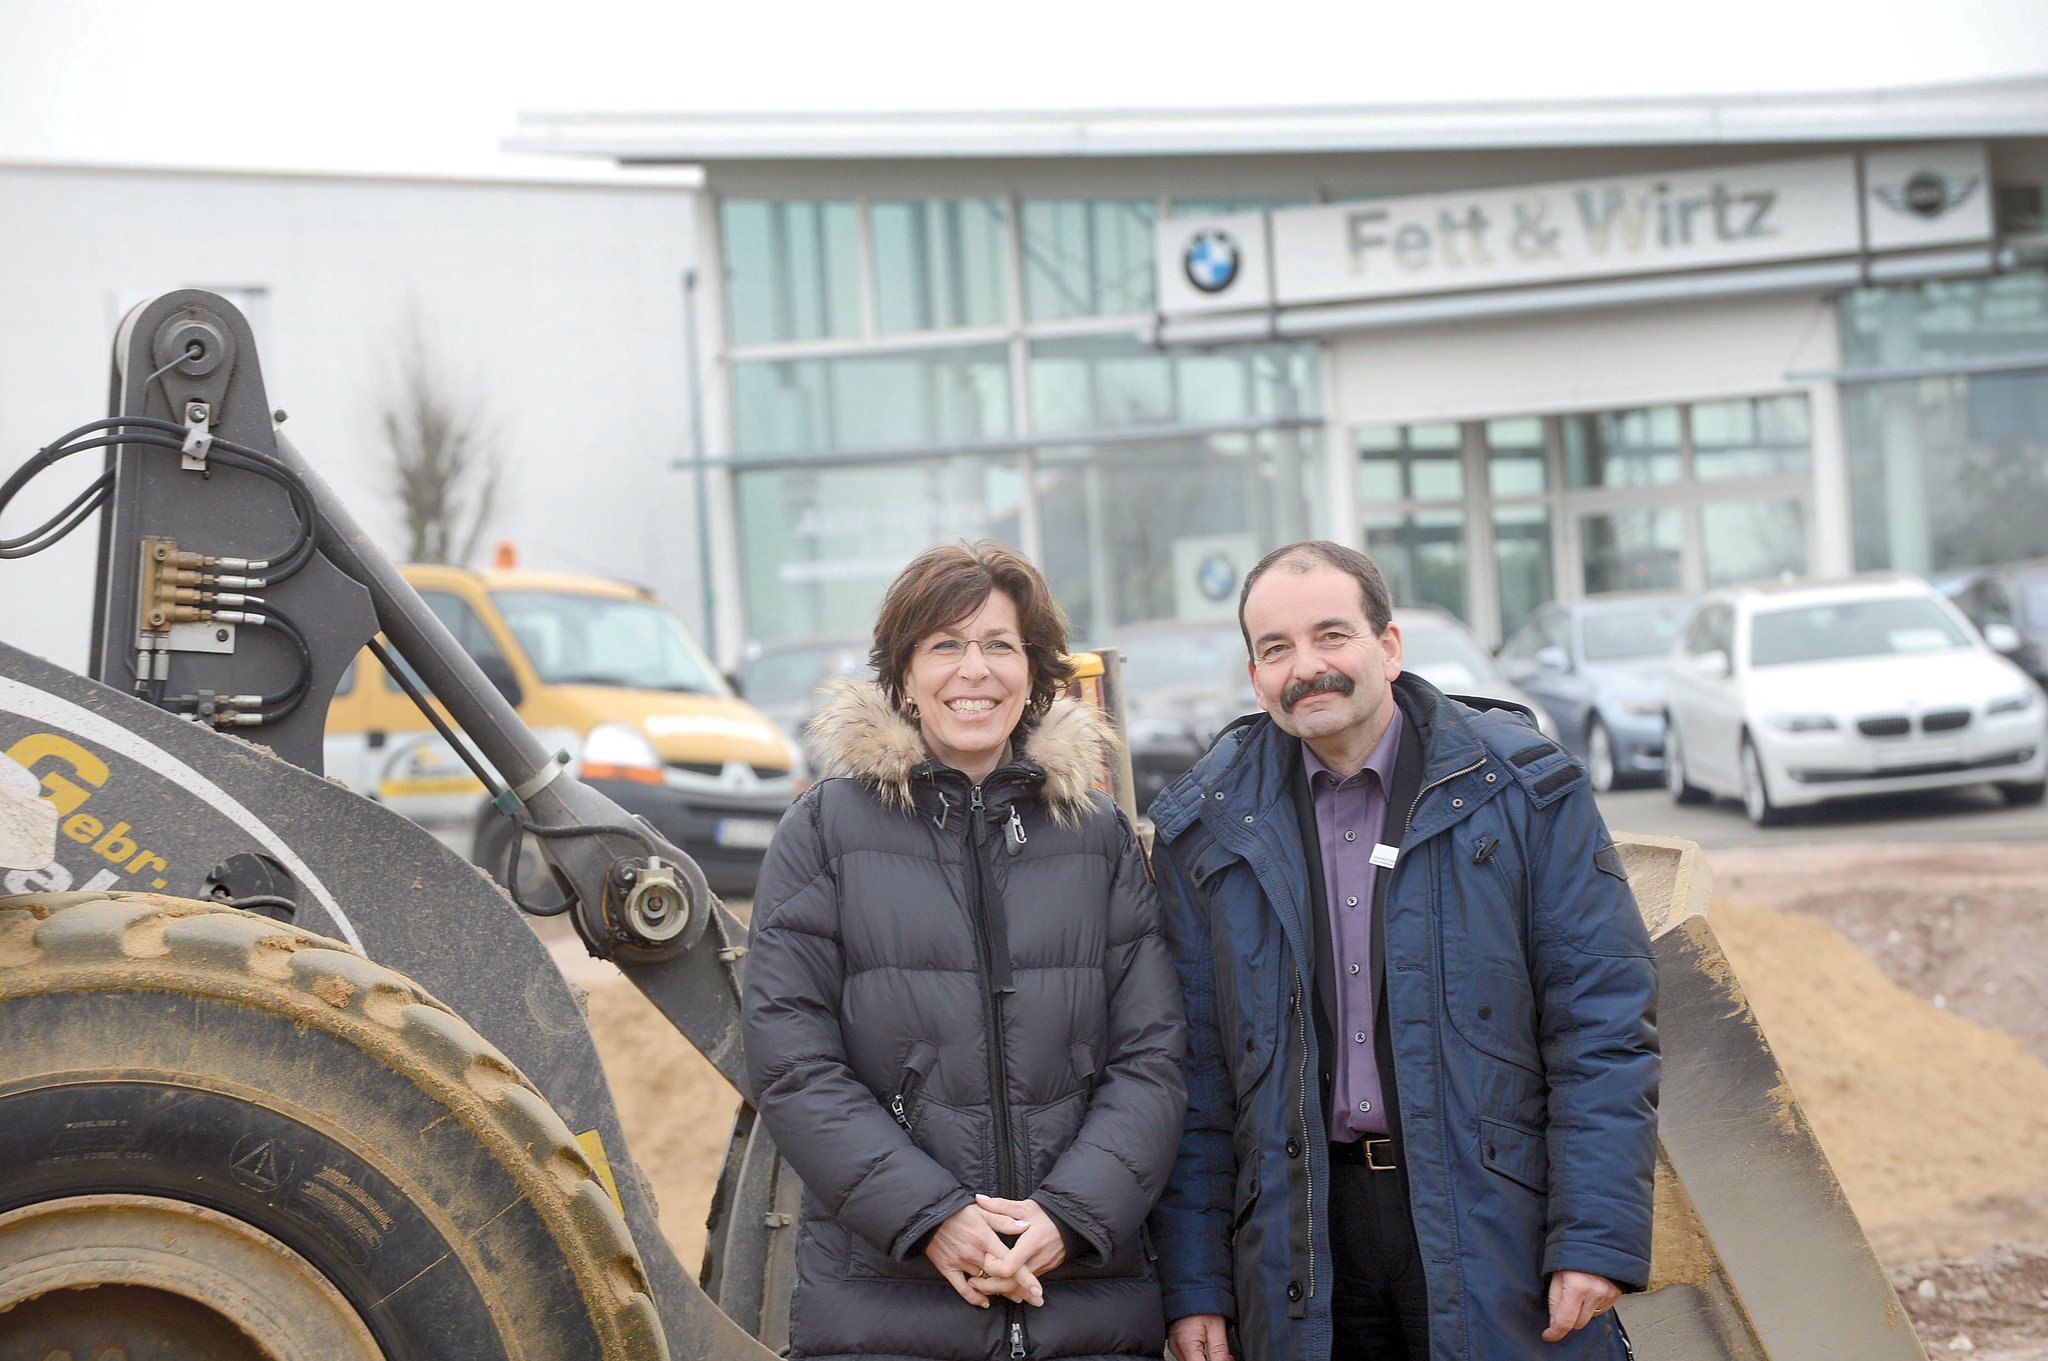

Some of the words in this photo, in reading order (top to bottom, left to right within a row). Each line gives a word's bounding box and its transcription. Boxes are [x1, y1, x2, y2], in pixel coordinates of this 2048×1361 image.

[1346, 203, 1496, 277] Fett
[1510, 197, 1562, 263] &
[1574, 180, 1781, 256] Wirtz
[6, 733, 168, 890] Gebr.
